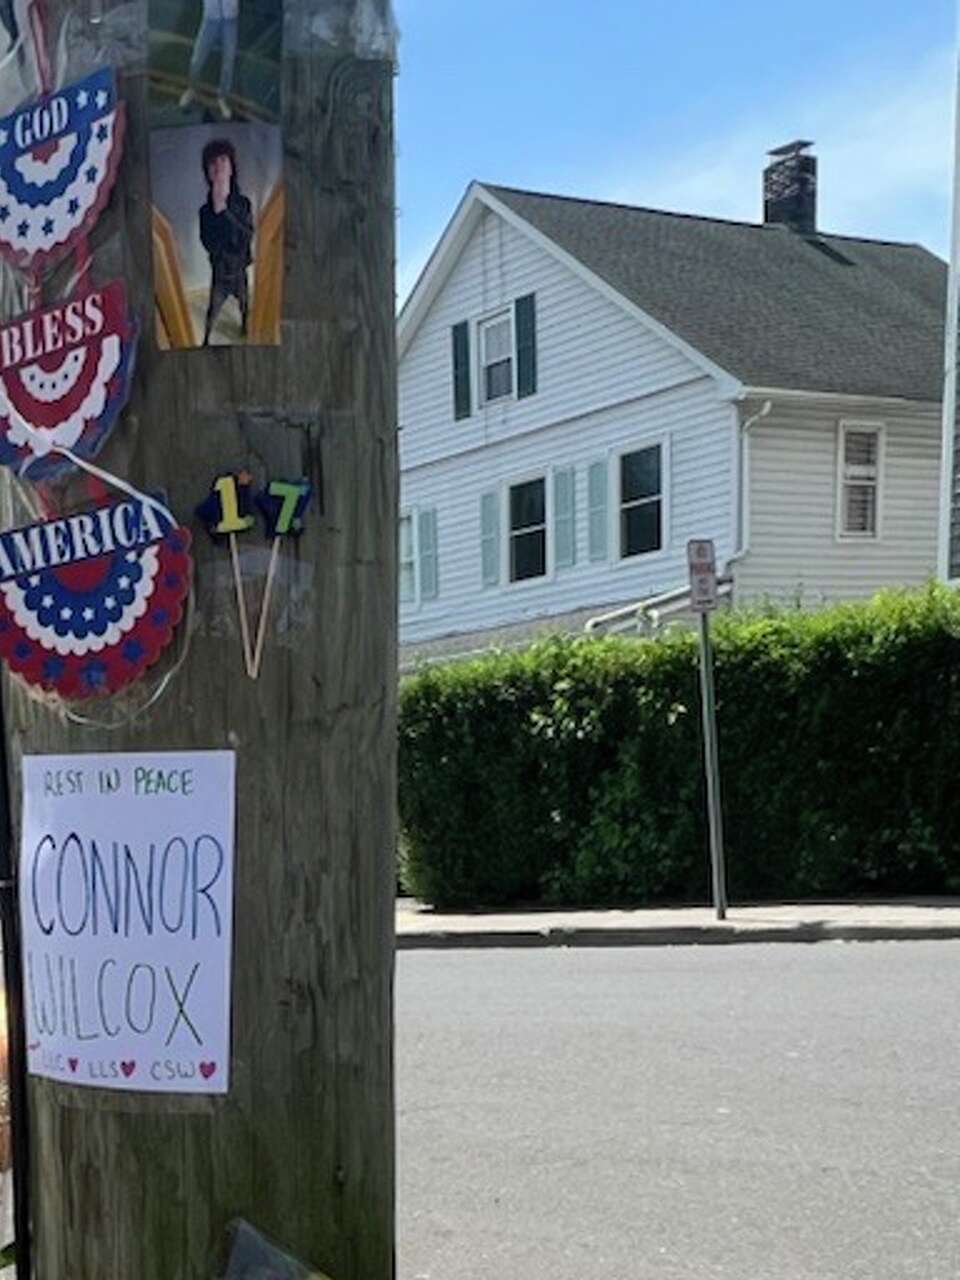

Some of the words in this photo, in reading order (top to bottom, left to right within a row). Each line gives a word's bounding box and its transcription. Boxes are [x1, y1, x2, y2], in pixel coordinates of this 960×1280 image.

[13, 97, 69, 149] GOD
[0, 293, 104, 366] BLESS
[43, 768, 83, 796] REST
[99, 769, 122, 794] IN
[135, 766, 194, 796] PEACE
[32, 832, 224, 940] CONNOR
[27, 952, 203, 1047] WILCOX
[149, 1060, 197, 1082] CSW
